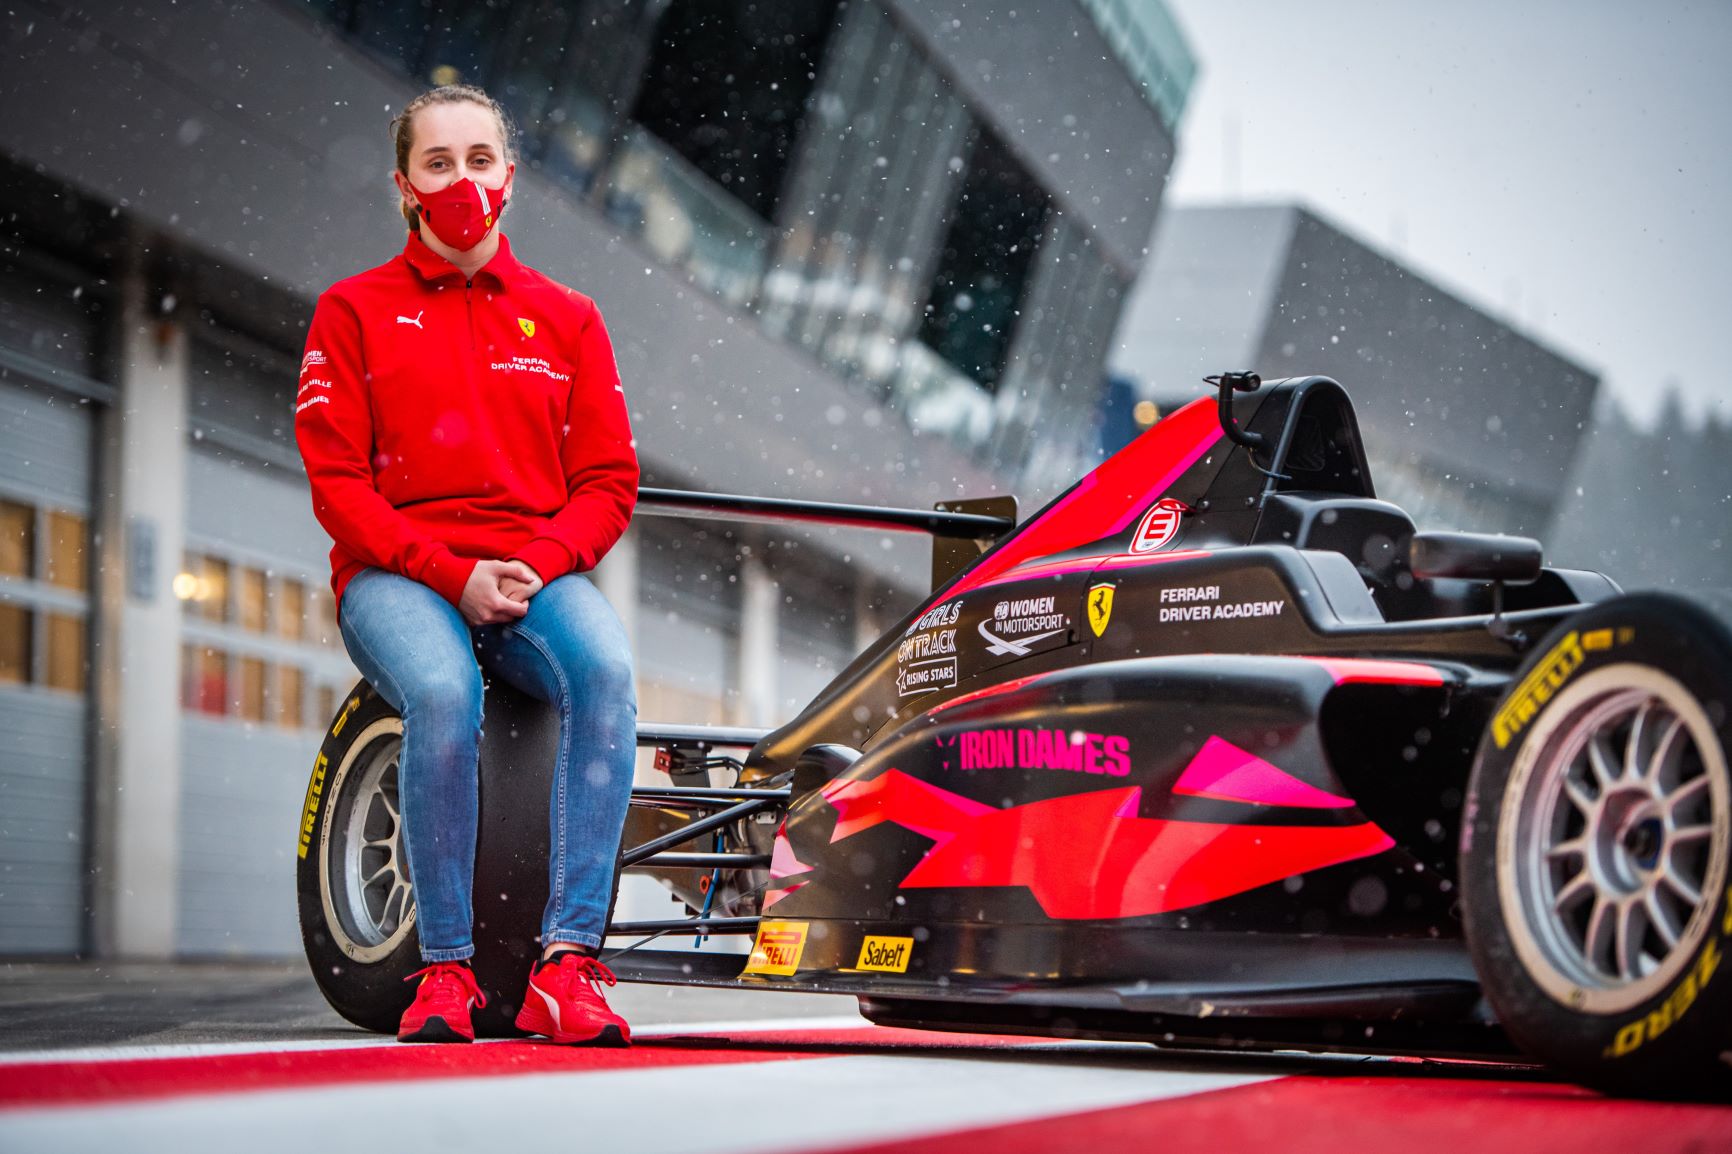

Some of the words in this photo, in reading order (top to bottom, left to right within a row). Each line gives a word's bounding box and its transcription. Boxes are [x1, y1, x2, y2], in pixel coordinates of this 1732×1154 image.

[491, 363, 527, 371] DRIVER
[528, 365, 570, 382] ACADEMY
[512, 356, 550, 369] FERRARI
[308, 379, 332, 388] MILLE
[1144, 513, 1173, 540] E
[1160, 586, 1220, 603] FERRARI
[919, 600, 964, 630] GIRLS
[1010, 596, 1055, 617] WOMEN
[1159, 605, 1211, 622] DRIVER
[1213, 601, 1285, 620] ACADEMY
[995, 621, 1003, 632] IN
[1003, 613, 1064, 634] MOTORSPORT
[915, 629, 957, 659] TRACK
[906, 669, 929, 686] RISING
[930, 665, 954, 681] STARS
[959, 728, 1014, 771] IRON
[1017, 728, 1132, 777] DAMES
[297, 750, 329, 860] PIRELLI
[751, 931, 802, 966] PRELLI
[864, 940, 905, 968] Sabelt
